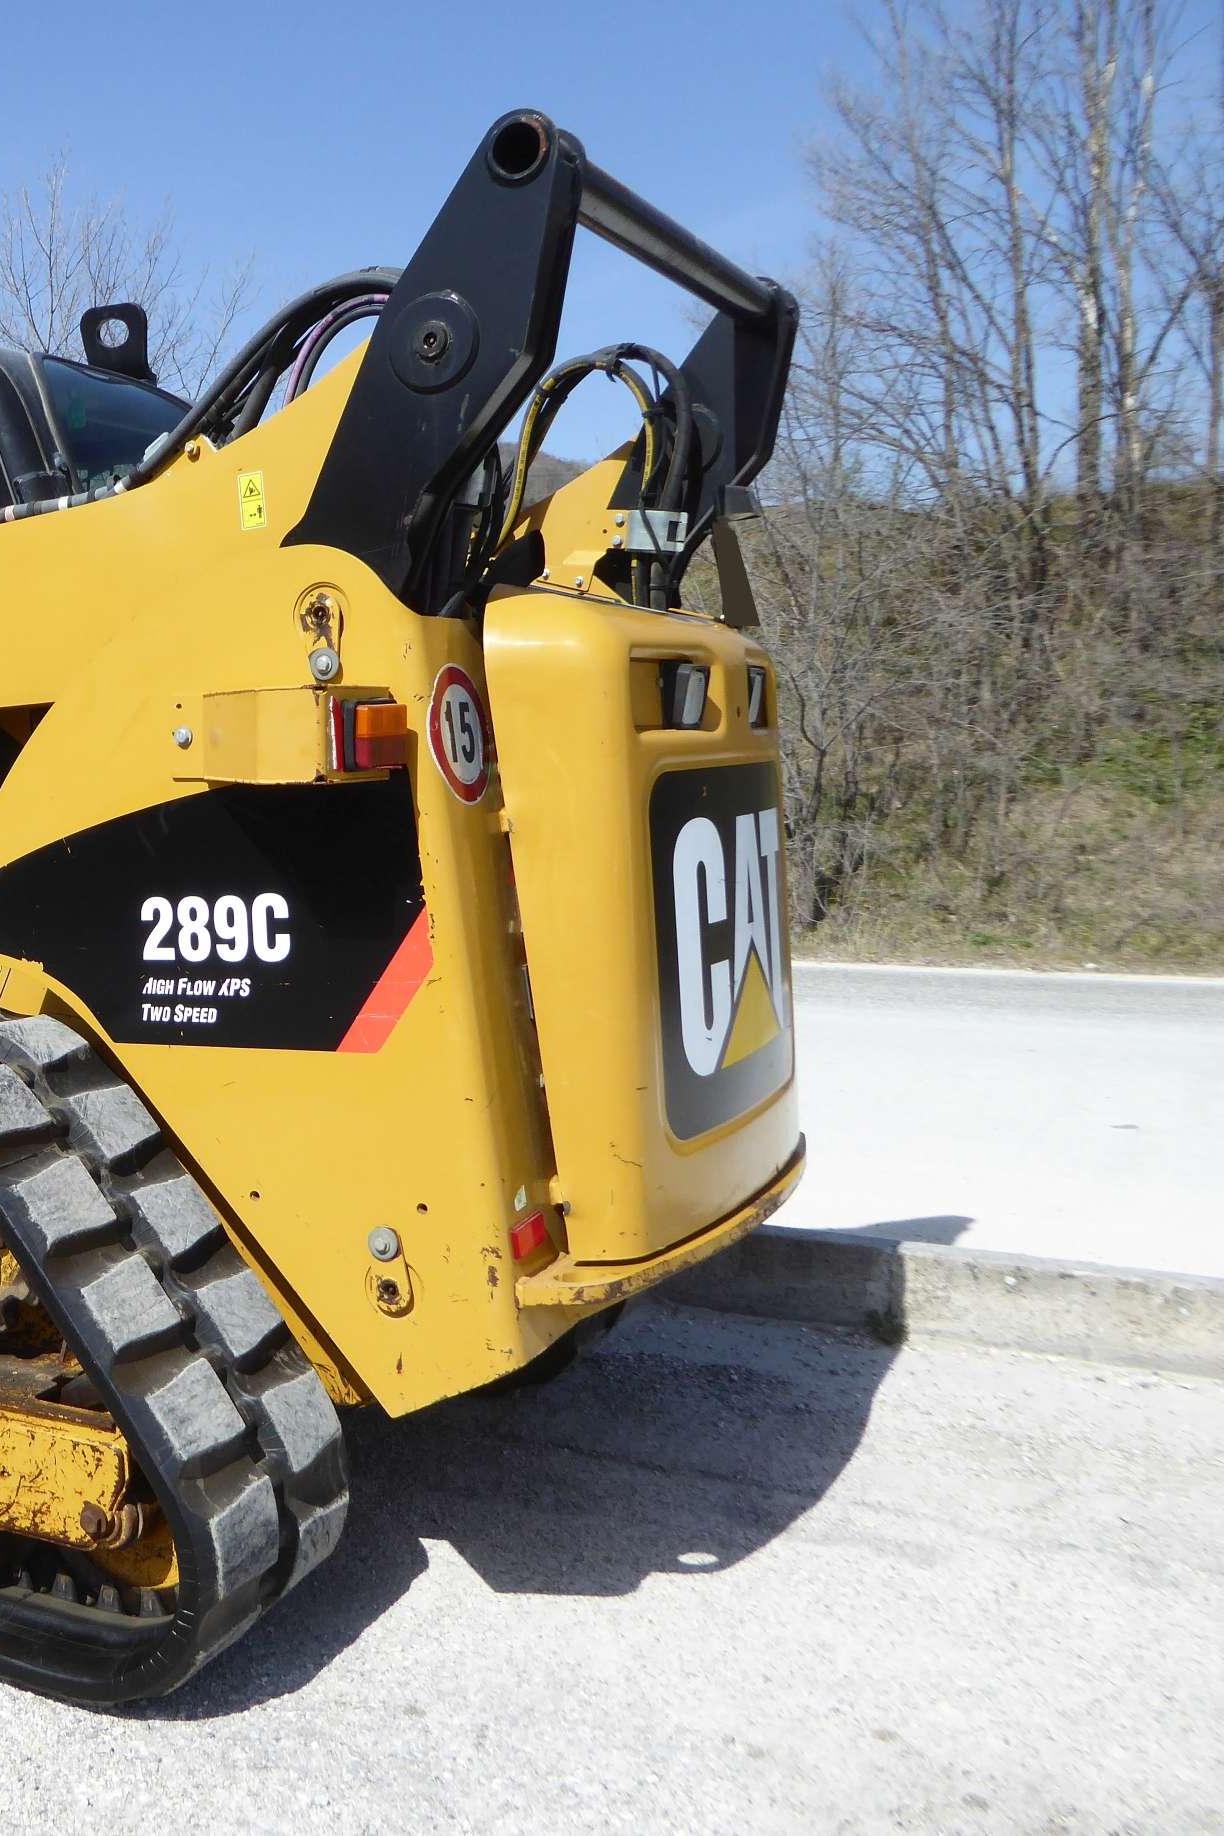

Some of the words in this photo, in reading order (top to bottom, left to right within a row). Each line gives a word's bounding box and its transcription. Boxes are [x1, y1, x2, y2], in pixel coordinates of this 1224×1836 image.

[444, 701, 475, 763] 15
[140, 892, 291, 963] 289C
[673, 807, 785, 1076] CAT
[174, 1004, 217, 1023] SPEED
[177, 977, 216, 996] FLOW
